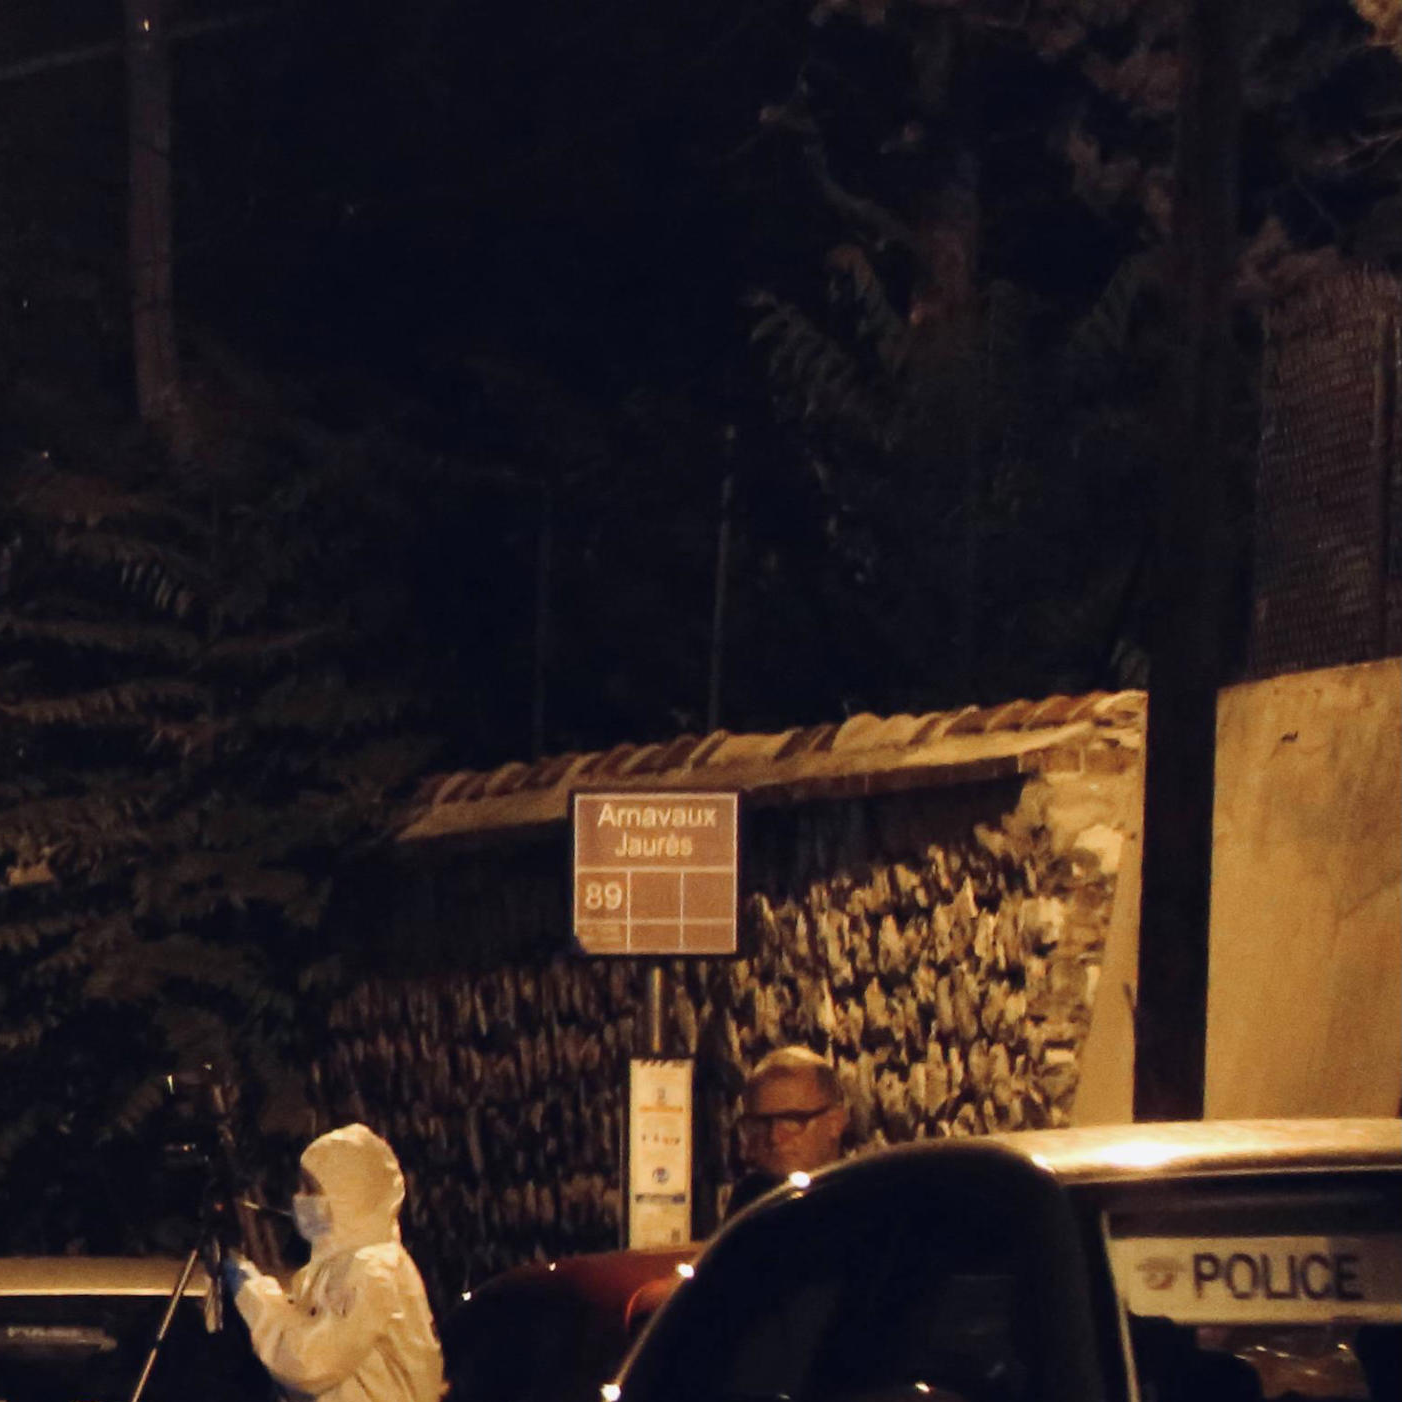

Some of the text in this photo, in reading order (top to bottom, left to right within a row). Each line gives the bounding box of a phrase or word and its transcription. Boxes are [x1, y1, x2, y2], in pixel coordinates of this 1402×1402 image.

[598, 803, 717, 828] Arnavaux
[615, 832, 693, 857] Jaurès
[585, 881, 622, 910] 89
[1192, 1252, 1363, 1300] POLICE
